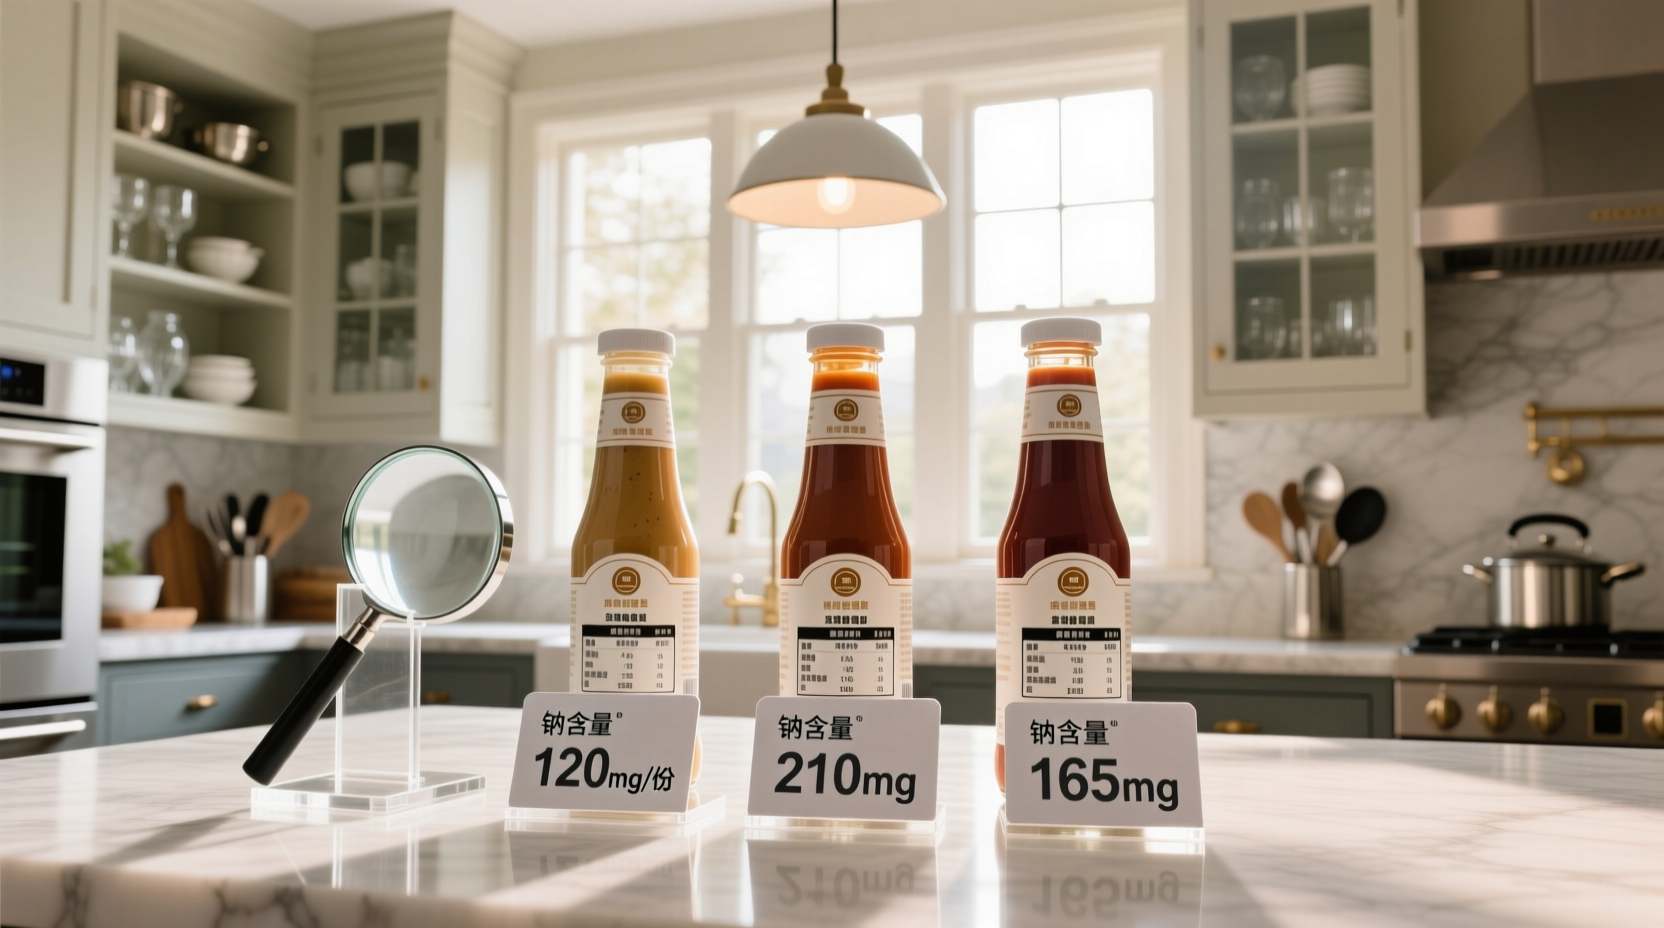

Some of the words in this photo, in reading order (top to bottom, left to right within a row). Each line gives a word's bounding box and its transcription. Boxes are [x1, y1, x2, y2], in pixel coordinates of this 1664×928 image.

[541, 710, 612, 736] 钠含量
[778, 714, 853, 740] 钠含量
[1030, 719, 1109, 745] 钠含量
[535, 747, 675, 794] 120mg/份
[774, 751, 916, 804] 210mg
[1031, 757, 1179, 812] 165mg
